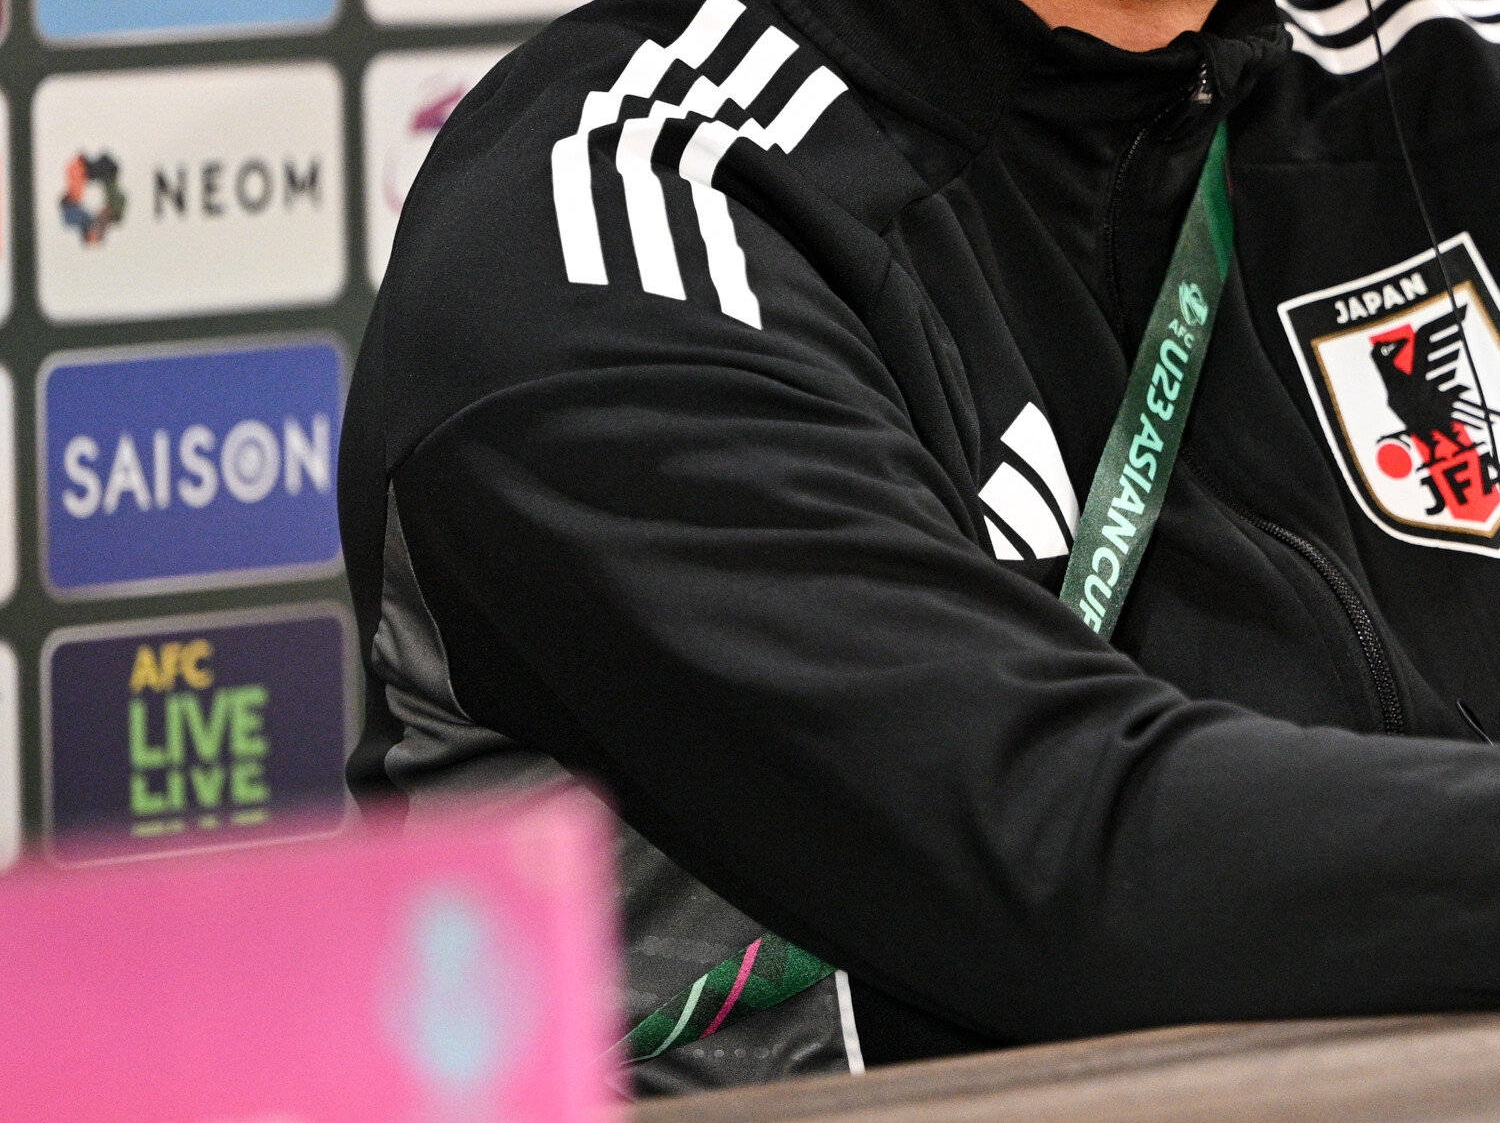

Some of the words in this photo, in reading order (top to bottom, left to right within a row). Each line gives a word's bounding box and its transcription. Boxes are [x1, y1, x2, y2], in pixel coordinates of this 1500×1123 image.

[153, 158, 325, 219] NEOM
[1167, 318, 1196, 350] AFC
[1334, 272, 1429, 324] JAPAN
[1146, 337, 1190, 422] U23
[62, 415, 331, 520] SAISON
[1101, 412, 1164, 557] ASIAN
[131, 639, 215, 693] AFC
[129, 685, 270, 770] LIVE
